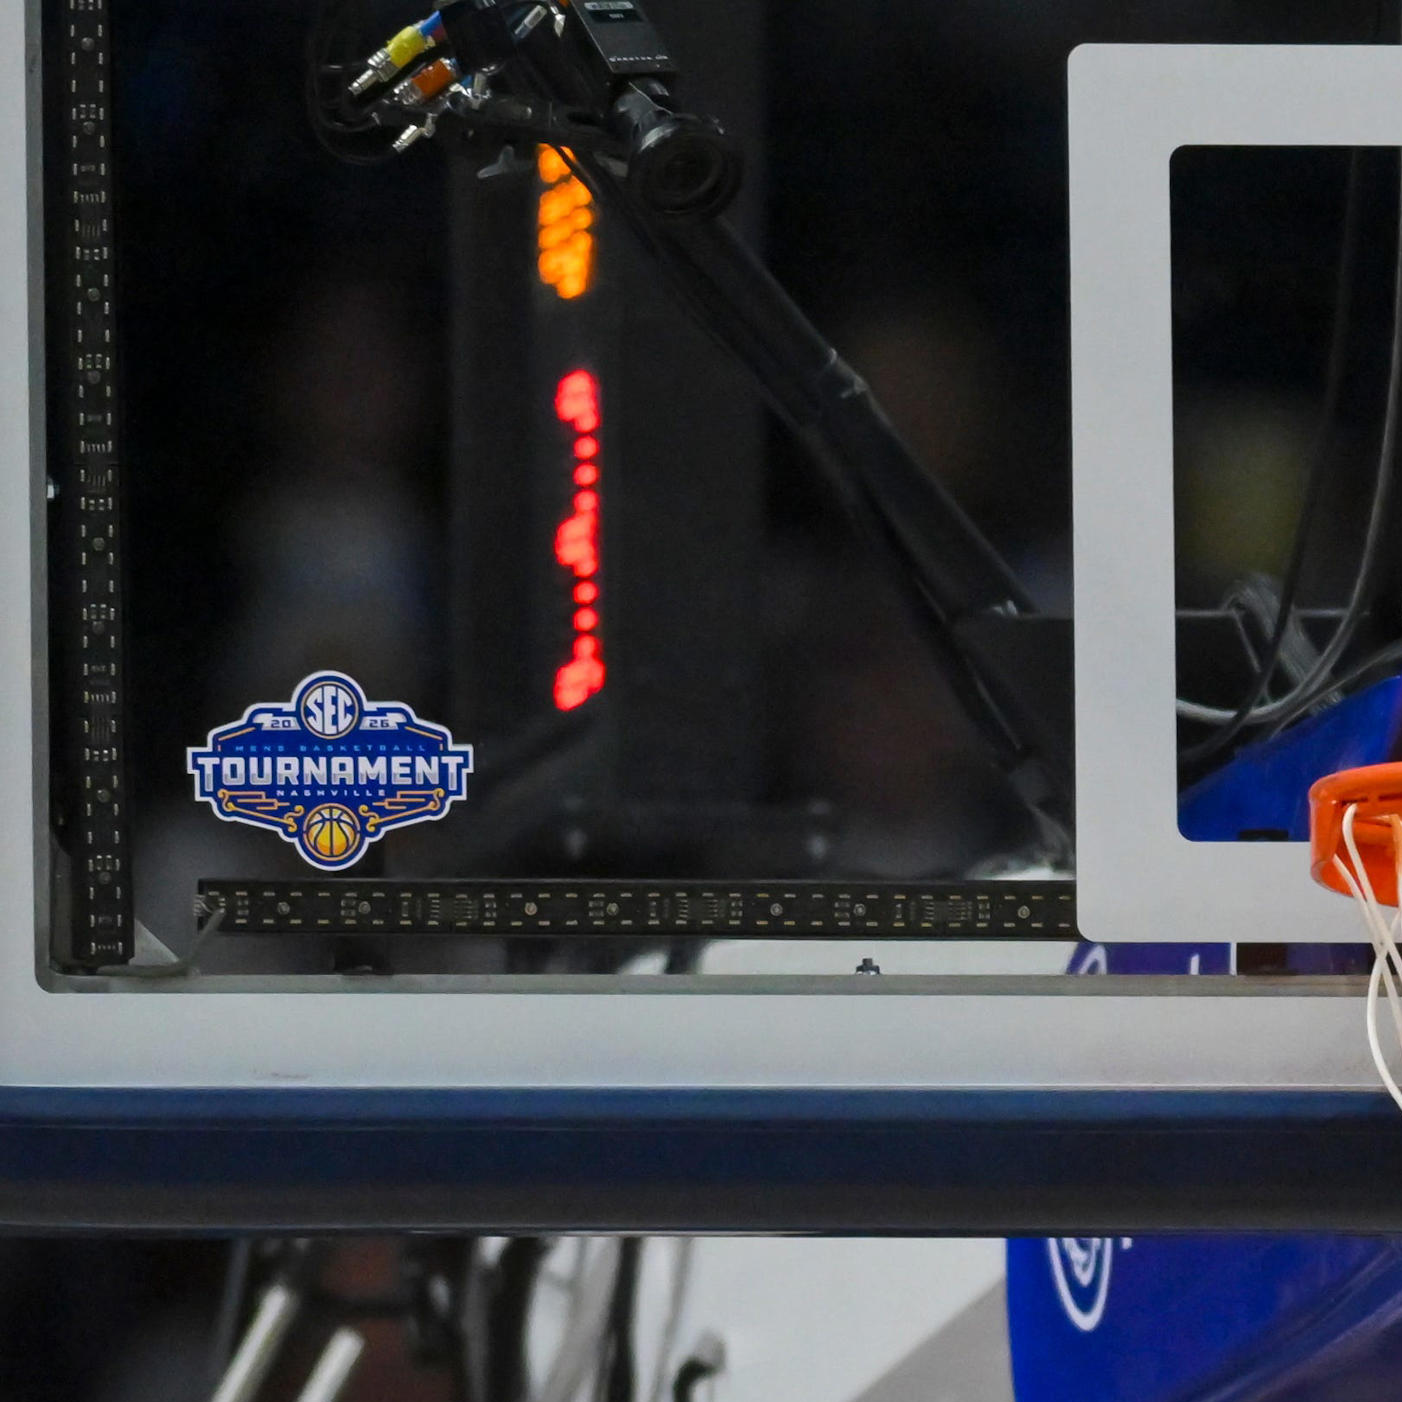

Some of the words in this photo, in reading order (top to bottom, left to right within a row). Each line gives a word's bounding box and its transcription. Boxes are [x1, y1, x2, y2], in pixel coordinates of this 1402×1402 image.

[305, 685, 353, 735] SEC
[270, 719, 291, 729] 20
[368, 718, 390, 729] 26
[196, 756, 464, 792] TOURNAMENT
[276, 789, 386, 797] NASHVILLE
